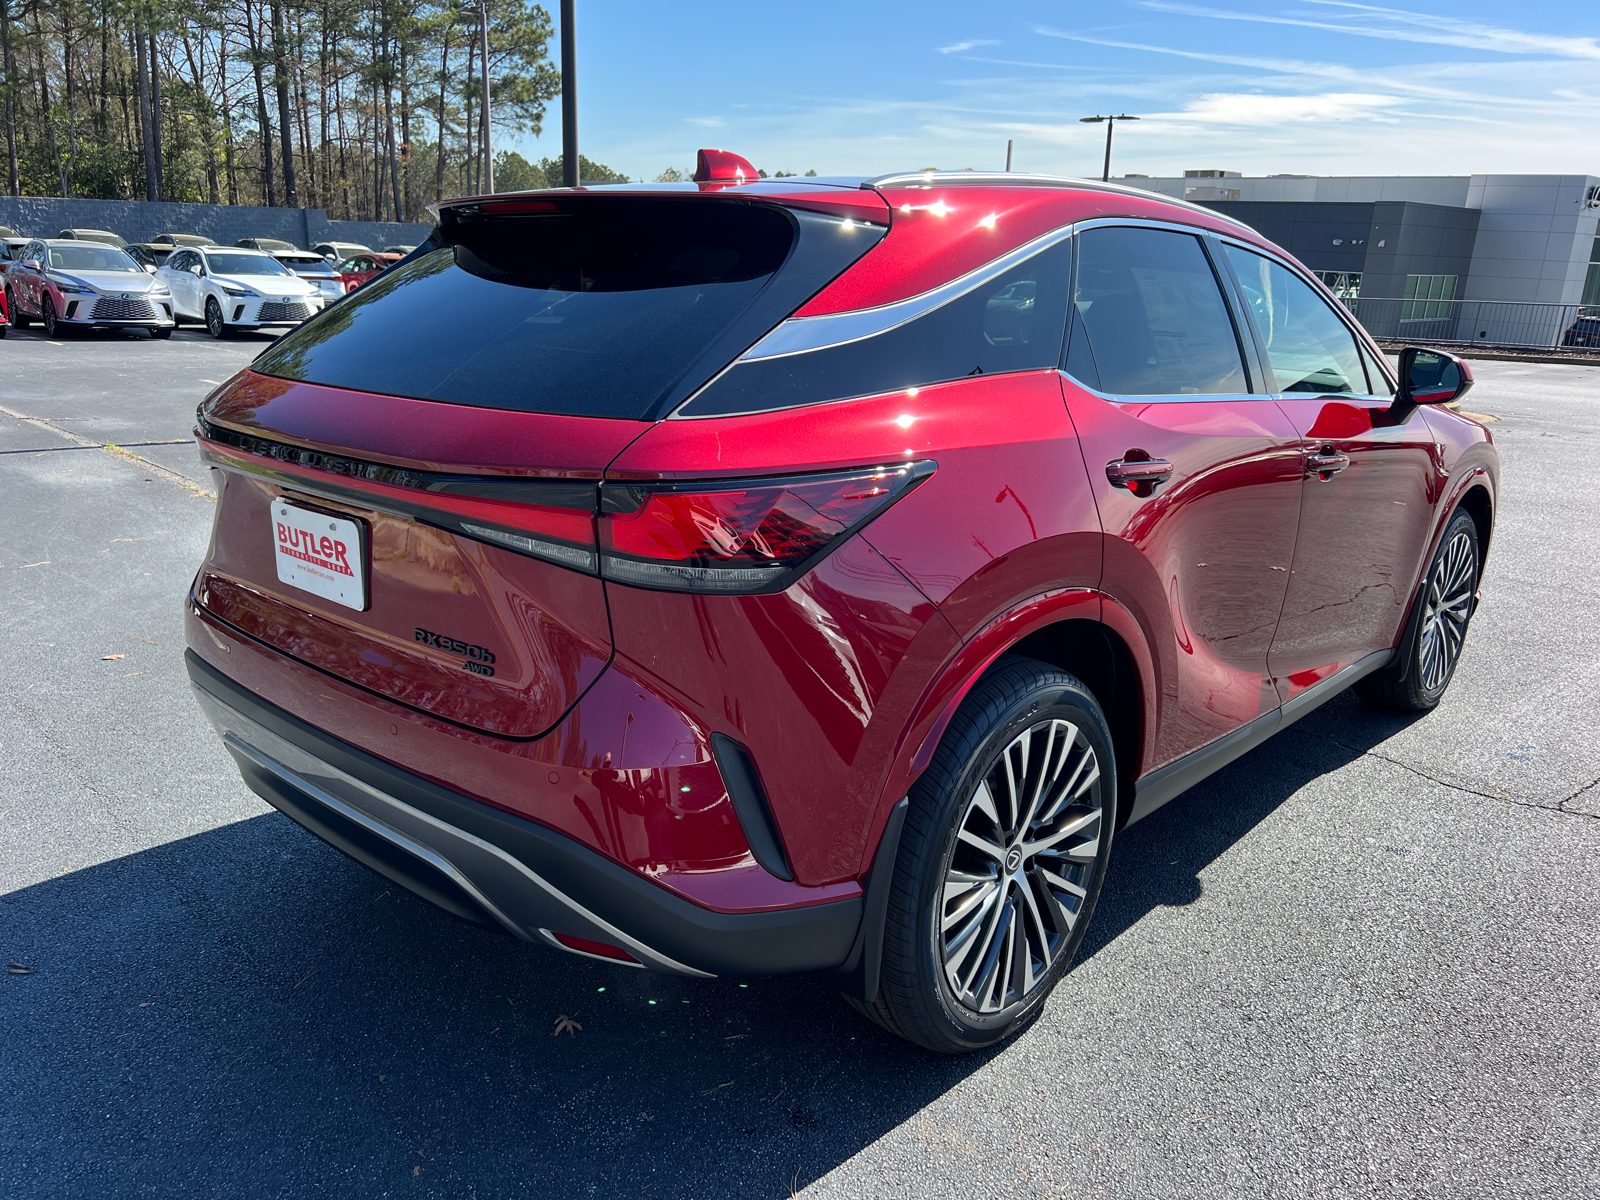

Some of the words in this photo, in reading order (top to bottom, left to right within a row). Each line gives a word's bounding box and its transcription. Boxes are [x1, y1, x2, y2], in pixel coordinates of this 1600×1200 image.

[327, 562, 351, 575] GROUP
[413, 627, 496, 664] RX350h
[462, 661, 495, 677] AWD
